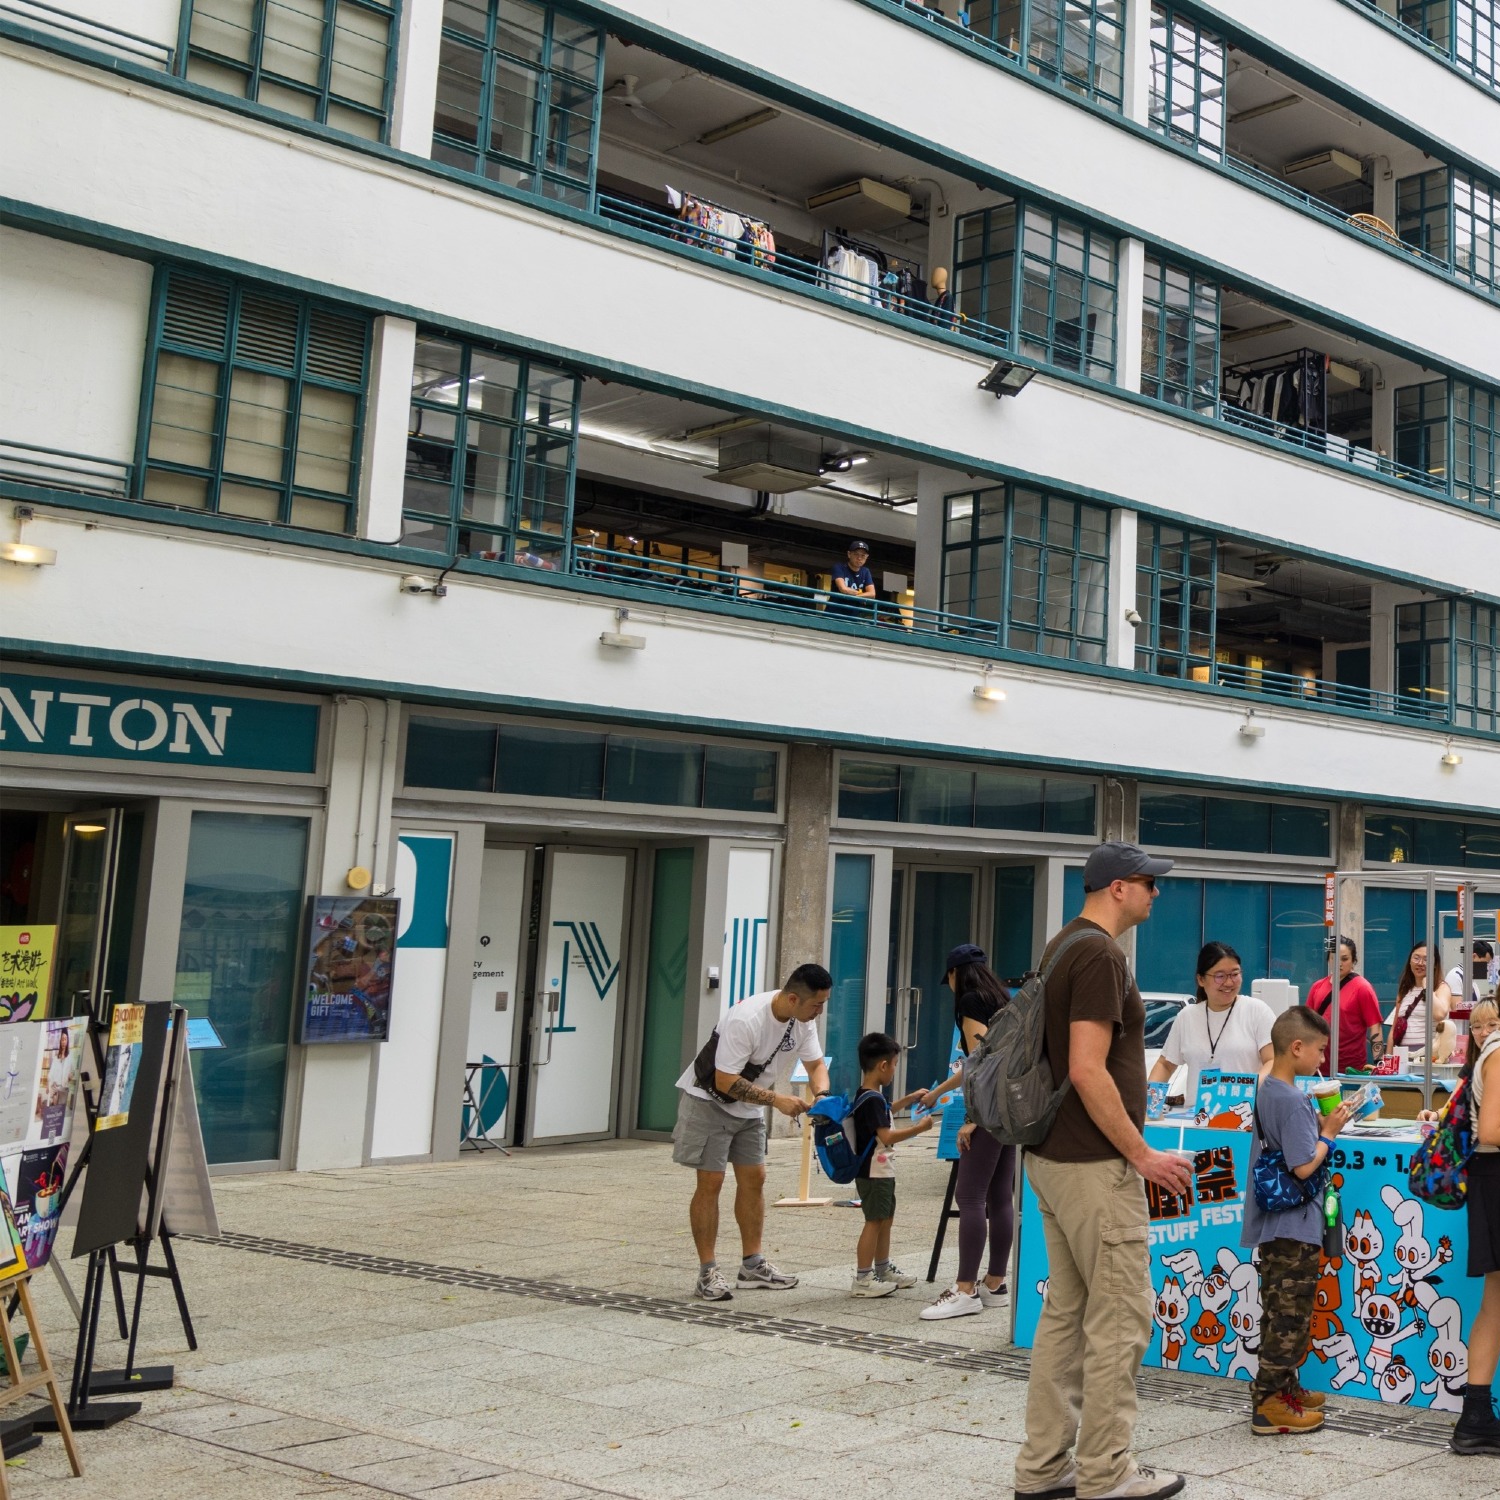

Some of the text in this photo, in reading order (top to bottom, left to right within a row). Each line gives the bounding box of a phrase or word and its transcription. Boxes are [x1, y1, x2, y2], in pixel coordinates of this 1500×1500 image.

[0, 686, 232, 756] NTON
[311, 993, 353, 1005] WELCOME
[310, 1005, 329, 1017] GIFT
[1237, 1076, 1255, 1085] DESK
[17, 1212, 31, 1226] AN
[34, 1216, 58, 1233] SHOW
[1148, 1220, 1199, 1246] STUFF
